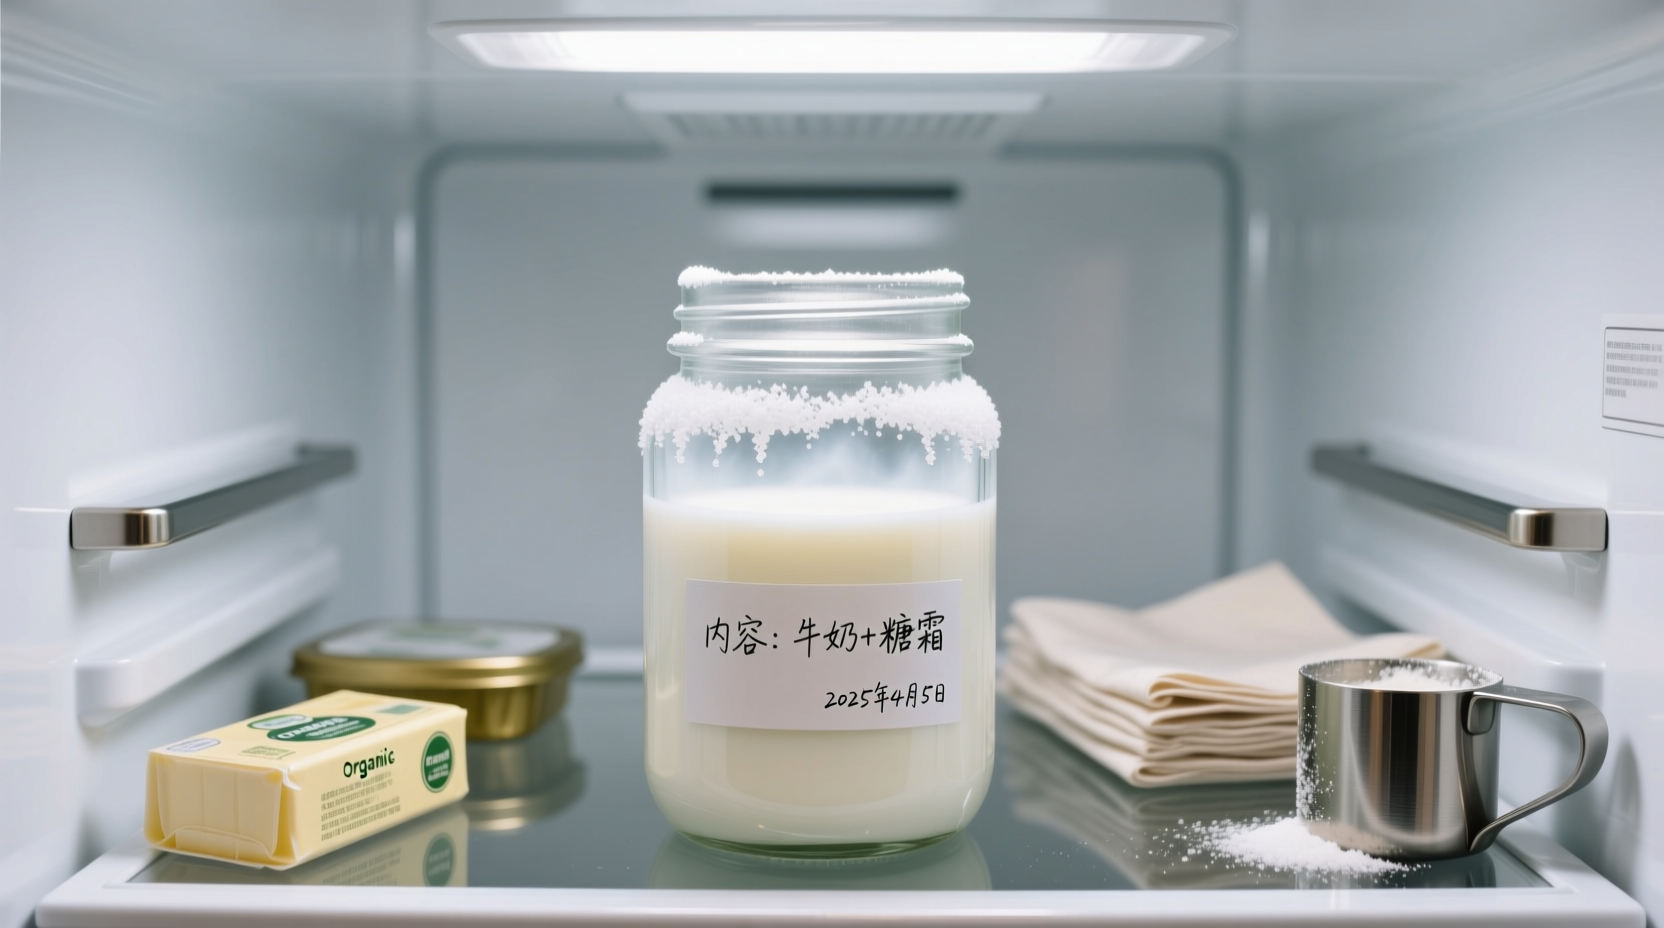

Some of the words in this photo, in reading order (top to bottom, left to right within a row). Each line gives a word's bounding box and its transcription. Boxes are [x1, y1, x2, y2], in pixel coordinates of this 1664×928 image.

[824, 681, 945, 713] 2025年4月5日
[343, 747, 395, 779] Organic
